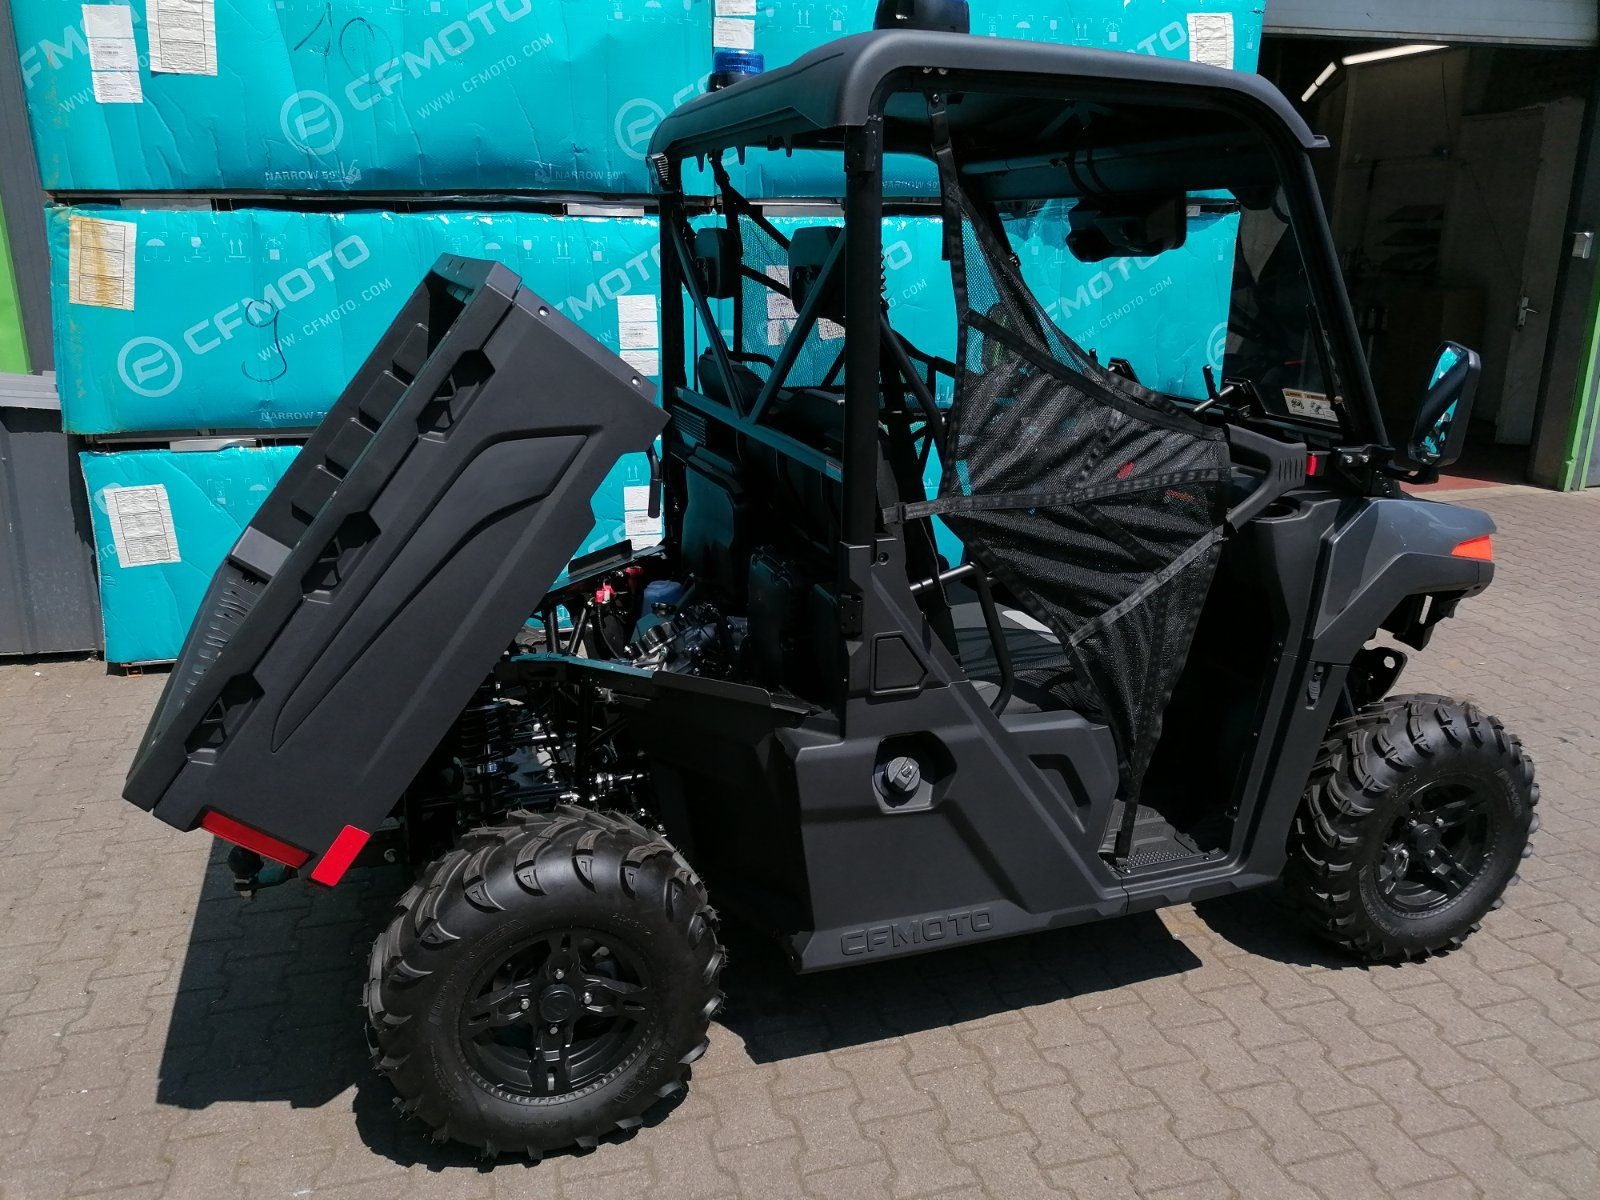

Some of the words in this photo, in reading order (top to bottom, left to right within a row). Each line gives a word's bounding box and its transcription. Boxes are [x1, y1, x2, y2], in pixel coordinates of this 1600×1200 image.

[345, 0, 532, 111] CFMOTO
[264, 170, 319, 181] NARROW
[555, 171, 604, 181] NARROW
[183, 234, 371, 355] CFMOTO
[261, 411, 314, 420] NARROW
[840, 907, 994, 957] CFMOTO
